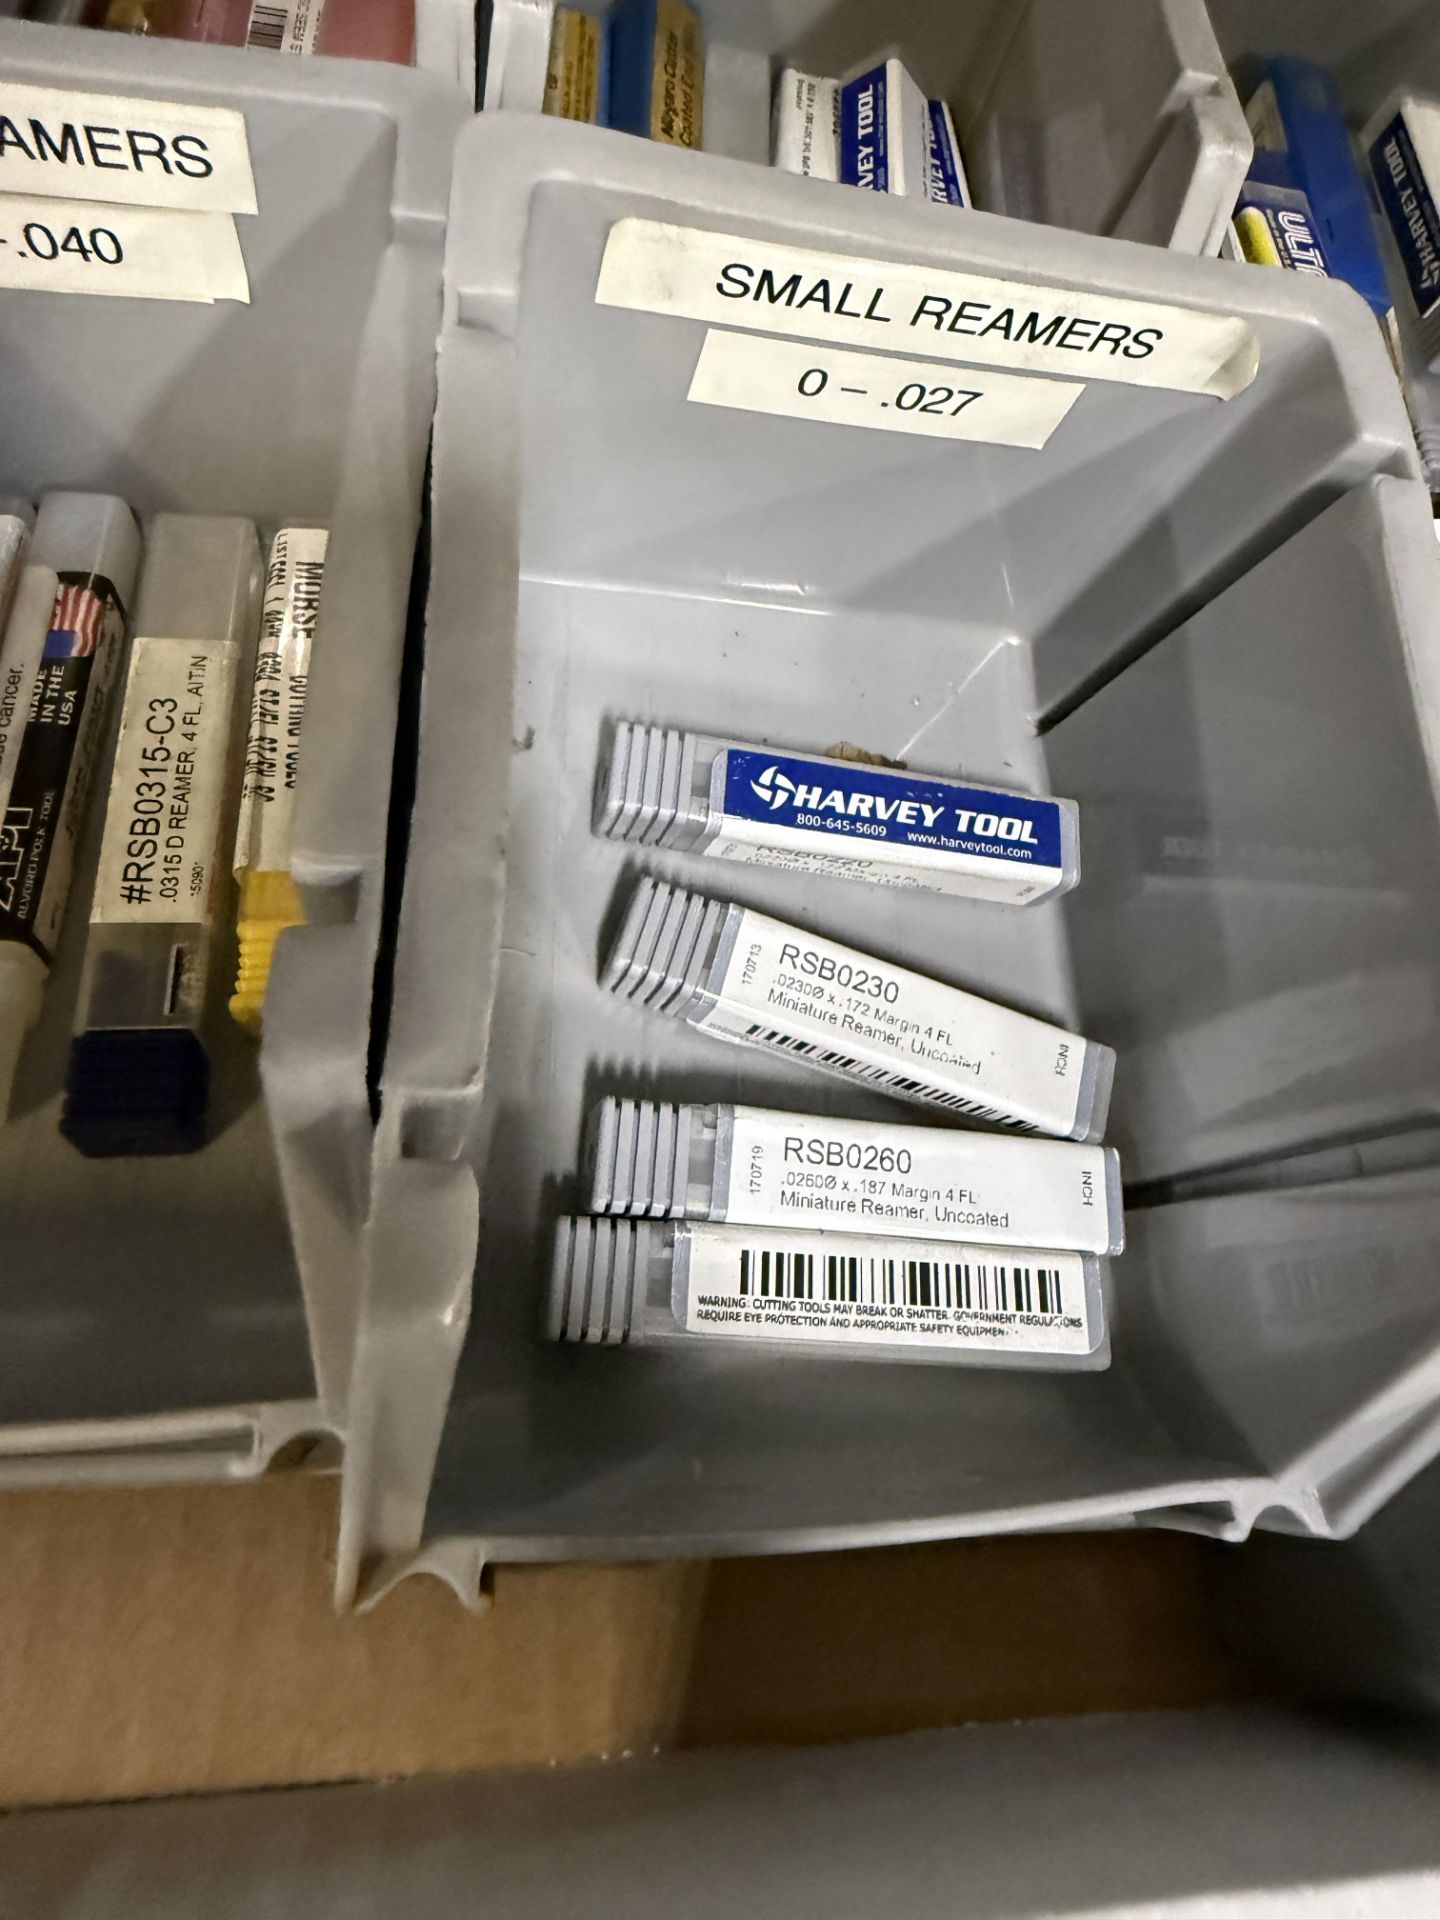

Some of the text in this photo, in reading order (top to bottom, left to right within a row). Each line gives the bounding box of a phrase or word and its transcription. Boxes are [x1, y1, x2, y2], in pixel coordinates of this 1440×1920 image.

[858, 84, 874, 141] TOOL
[1384, 137, 1408, 187] TOOL
[17, 222, 124, 265] .040
[1401, 187, 1440, 267] HARVEY
[715, 262, 1164, 360] SMALL REAMERS
[797, 367, 828, 398] 0
[881, 382, 984, 418] .027
[0, 662, 24, 727] cancer.
[40, 665, 65, 722] IN THE
[58, 690, 78, 725] USA
[181, 730, 197, 742] 4
[120, 698, 178, 904] #RSB0315-C3
[793, 783, 1039, 845] HARVEY TOOL
[166, 835, 184, 849] D
[796, 813, 887, 837] 800-645-5609
[907, 831, 1032, 860] www.harveytool.com
[159, 854, 182, 903] .0315
[741, 944, 762, 984] 170713
[779, 943, 900, 1004] RSB0230
[767, 987, 838, 1025] Miniature
[828, 993, 836, 1003] x
[838, 997, 871, 1016] .172
[874, 1008, 920, 1034] Margin
[924, 1024, 933, 1039] 4
[936, 1030, 953, 1046] FL
[1055, 1043, 1070, 1076] INCH
[749, 1145, 764, 1194] 170719
[784, 1136, 911, 1174] RSB0260
[780, 1190, 856, 1213] Miniature
[935, 1206, 1009, 1228] Uncoated
[841, 1181, 849, 1191] x
[853, 1179, 886, 1196] .187
[892, 1182, 940, 1202] Margin
[945, 1189, 954, 1201] 4
[959, 1190, 977, 1204] FL
[1081, 1171, 1093, 1206] INCH
[697, 1309, 742, 1323] REQUIRE
[744, 1312, 762, 1323] EYE
[764, 1313, 827, 1327] PROTECTION
[830, 1316, 850, 1328] AND
[852, 1317, 917, 1332] APPROPRIATE
[919, 1322, 954, 1334] SAFETY
[752, 1299, 796, 1312] CUTTING
[800, 1301, 831, 1314] TOOLS
[833, 1303, 853, 1315] MAY
[856, 1304, 887, 1317] BREAK
[890, 1306, 904, 1318] OR
